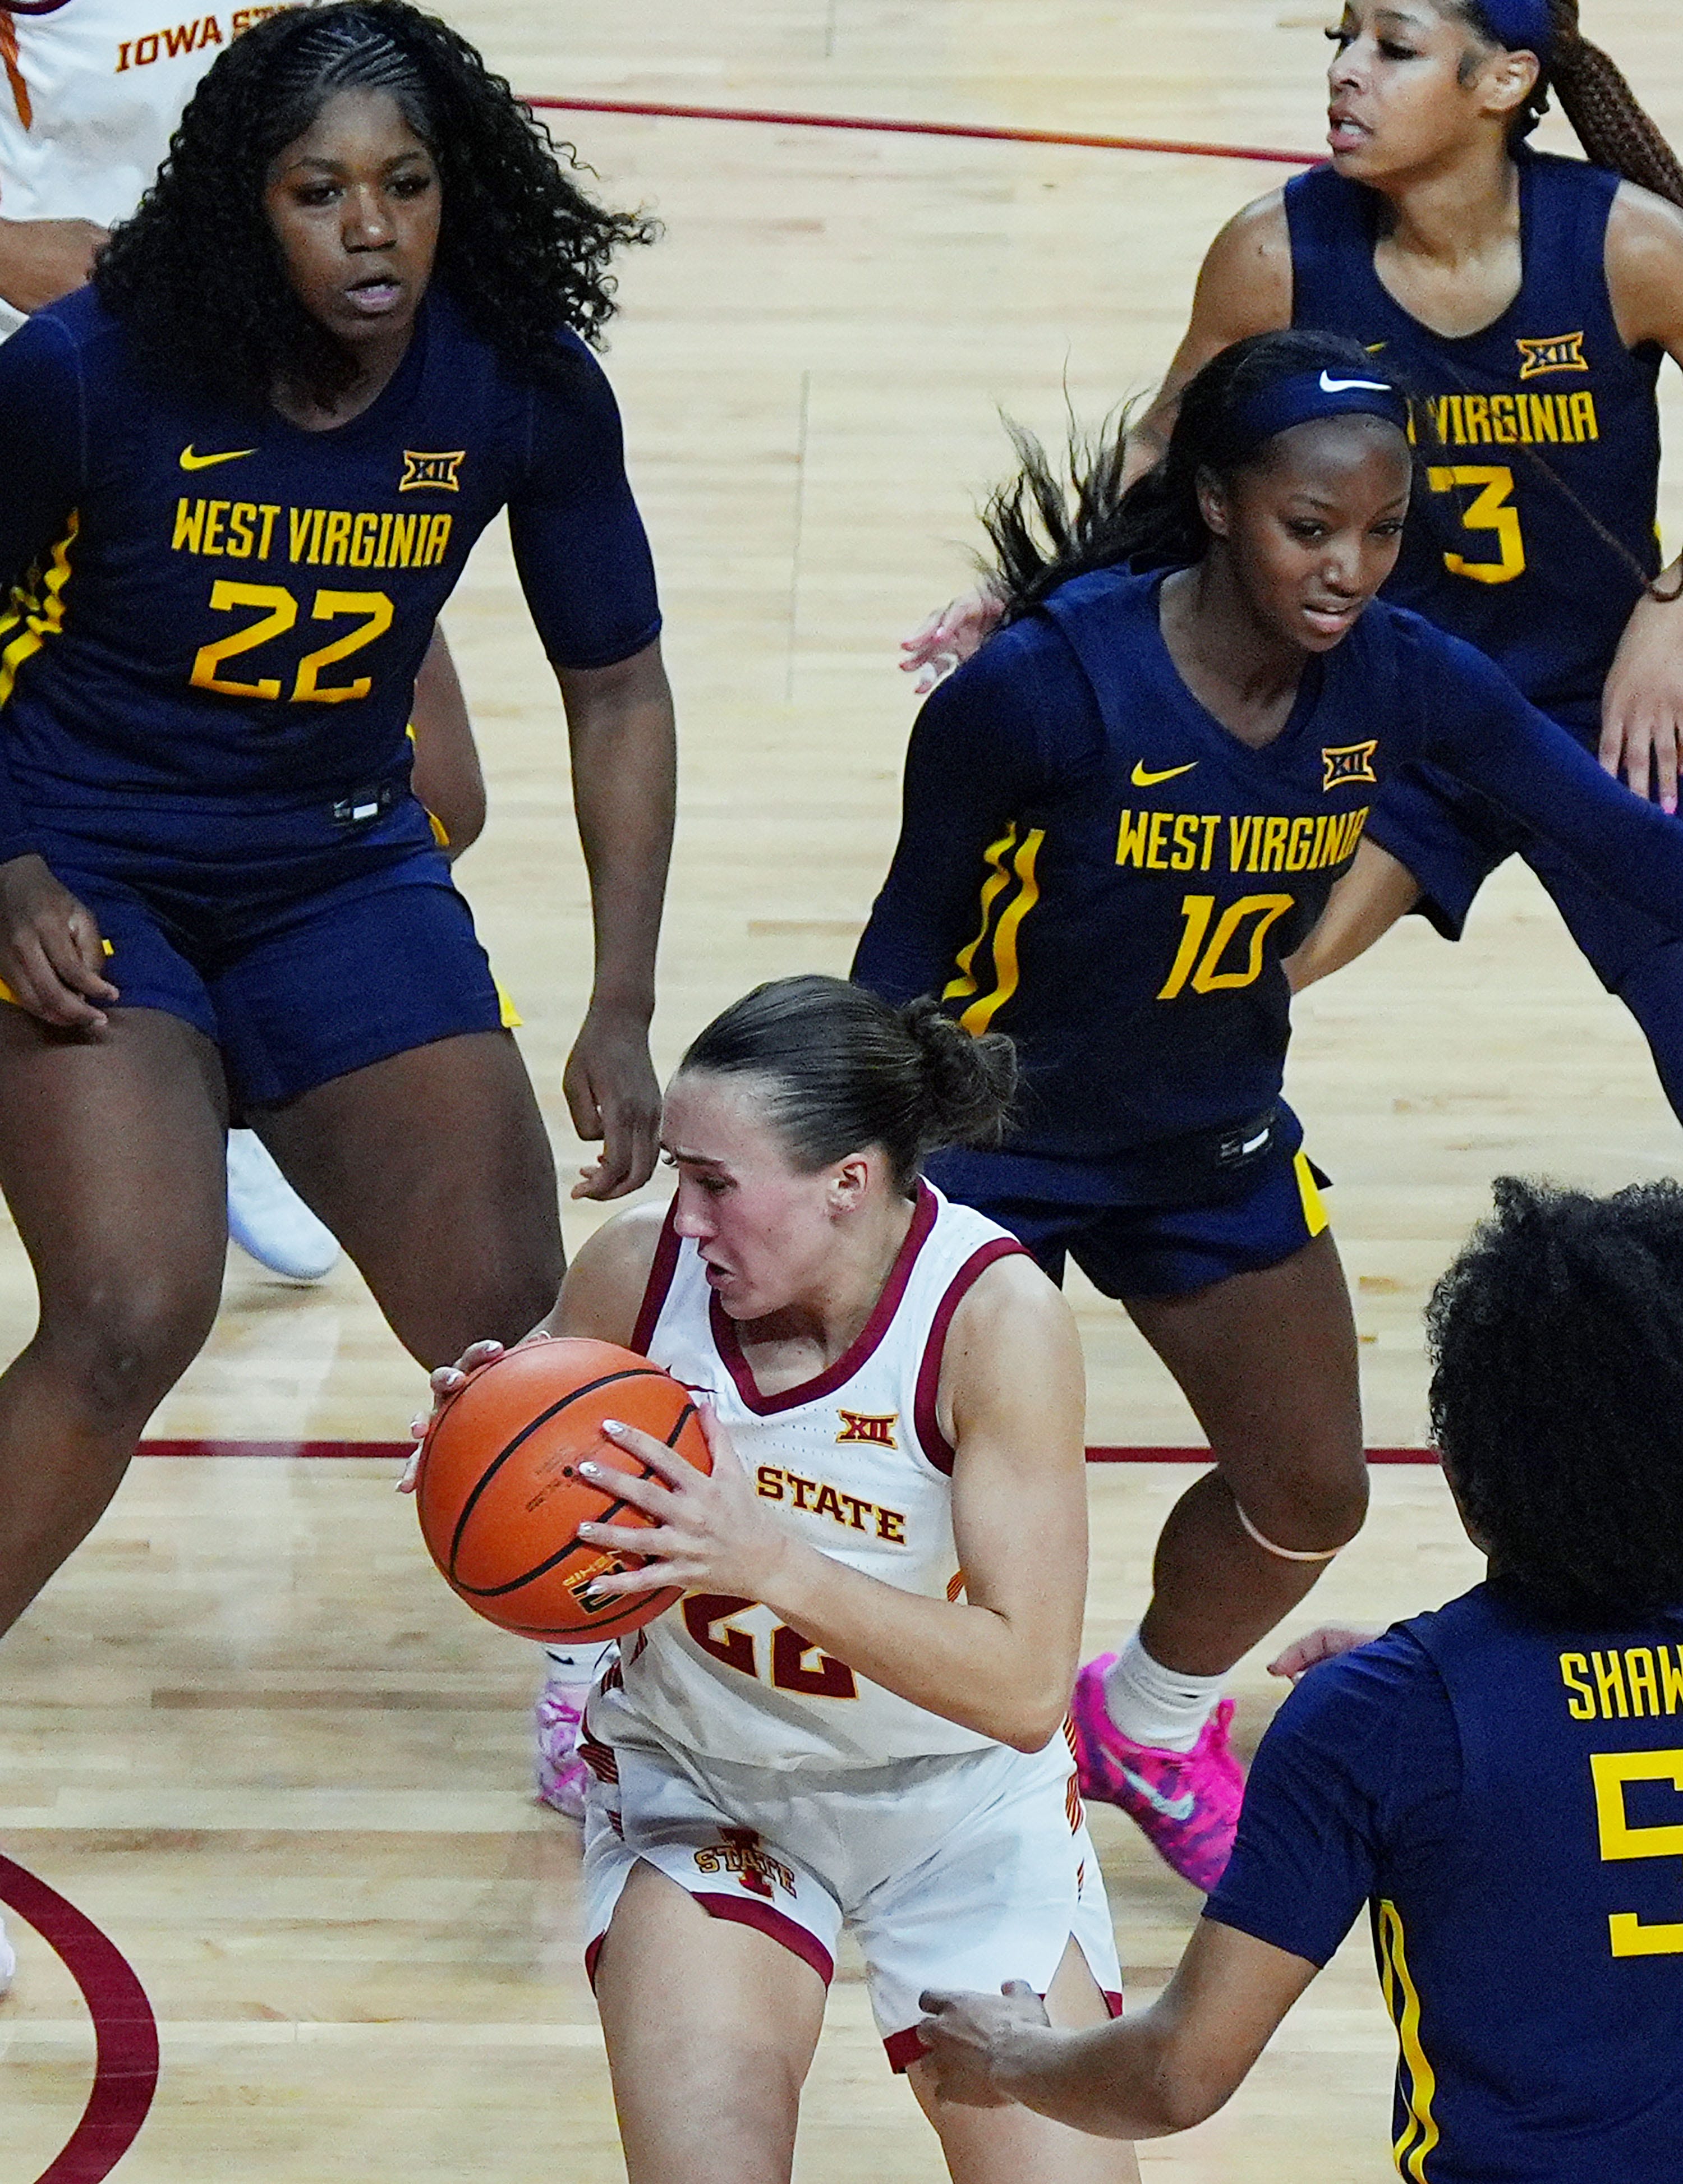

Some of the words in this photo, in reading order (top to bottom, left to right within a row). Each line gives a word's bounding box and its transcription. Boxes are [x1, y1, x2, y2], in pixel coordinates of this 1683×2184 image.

[116, 15, 223, 73] IOWA
[1517, 330, 1588, 380] XII
[171, 497, 281, 560] WEST
[289, 506, 453, 569] VIRGINIA
[1427, 465, 1526, 584] 3
[189, 579, 394, 702] 22
[1115, 808, 1221, 871] WEST
[1229, 806, 1369, 873] VIRGINIA
[1156, 893, 1295, 1000] 10
[836, 1409, 899, 1450] XII
[755, 1465, 907, 1546] STATE
[693, 1845, 797, 1900] STATE
